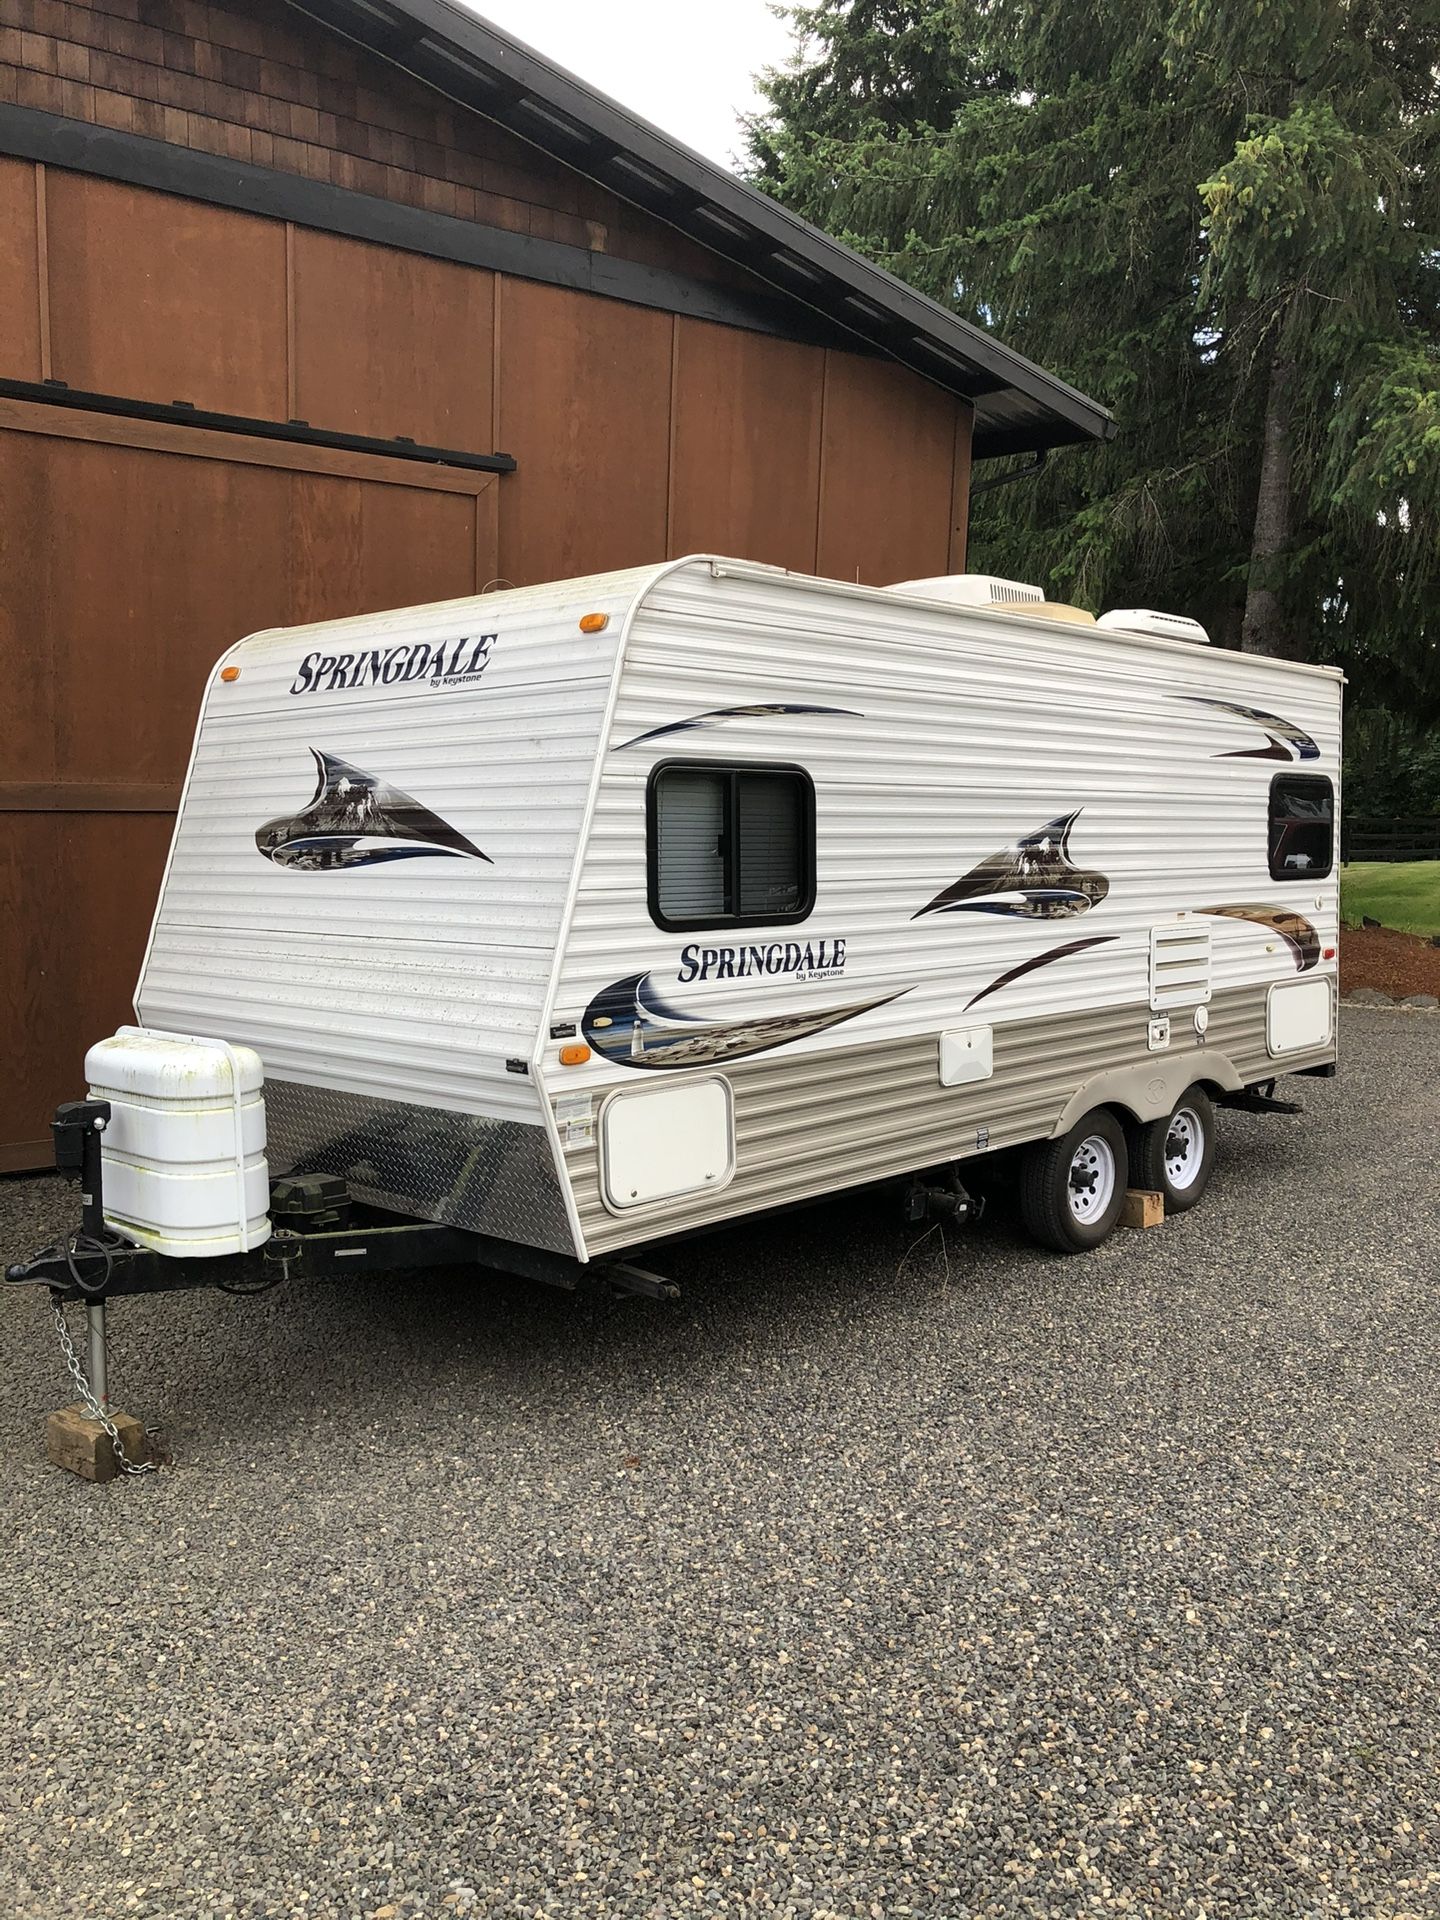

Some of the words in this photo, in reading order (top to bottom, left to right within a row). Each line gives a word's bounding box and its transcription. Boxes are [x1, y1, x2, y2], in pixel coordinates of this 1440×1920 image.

[289, 633, 499, 695] SPRINGDALE
[430, 679, 441, 688] by
[442, 674, 482, 686] Keystone
[677, 939, 847, 983] SPRINGDALE
[796, 972, 806, 982] by
[808, 969, 845, 979] Keystone
